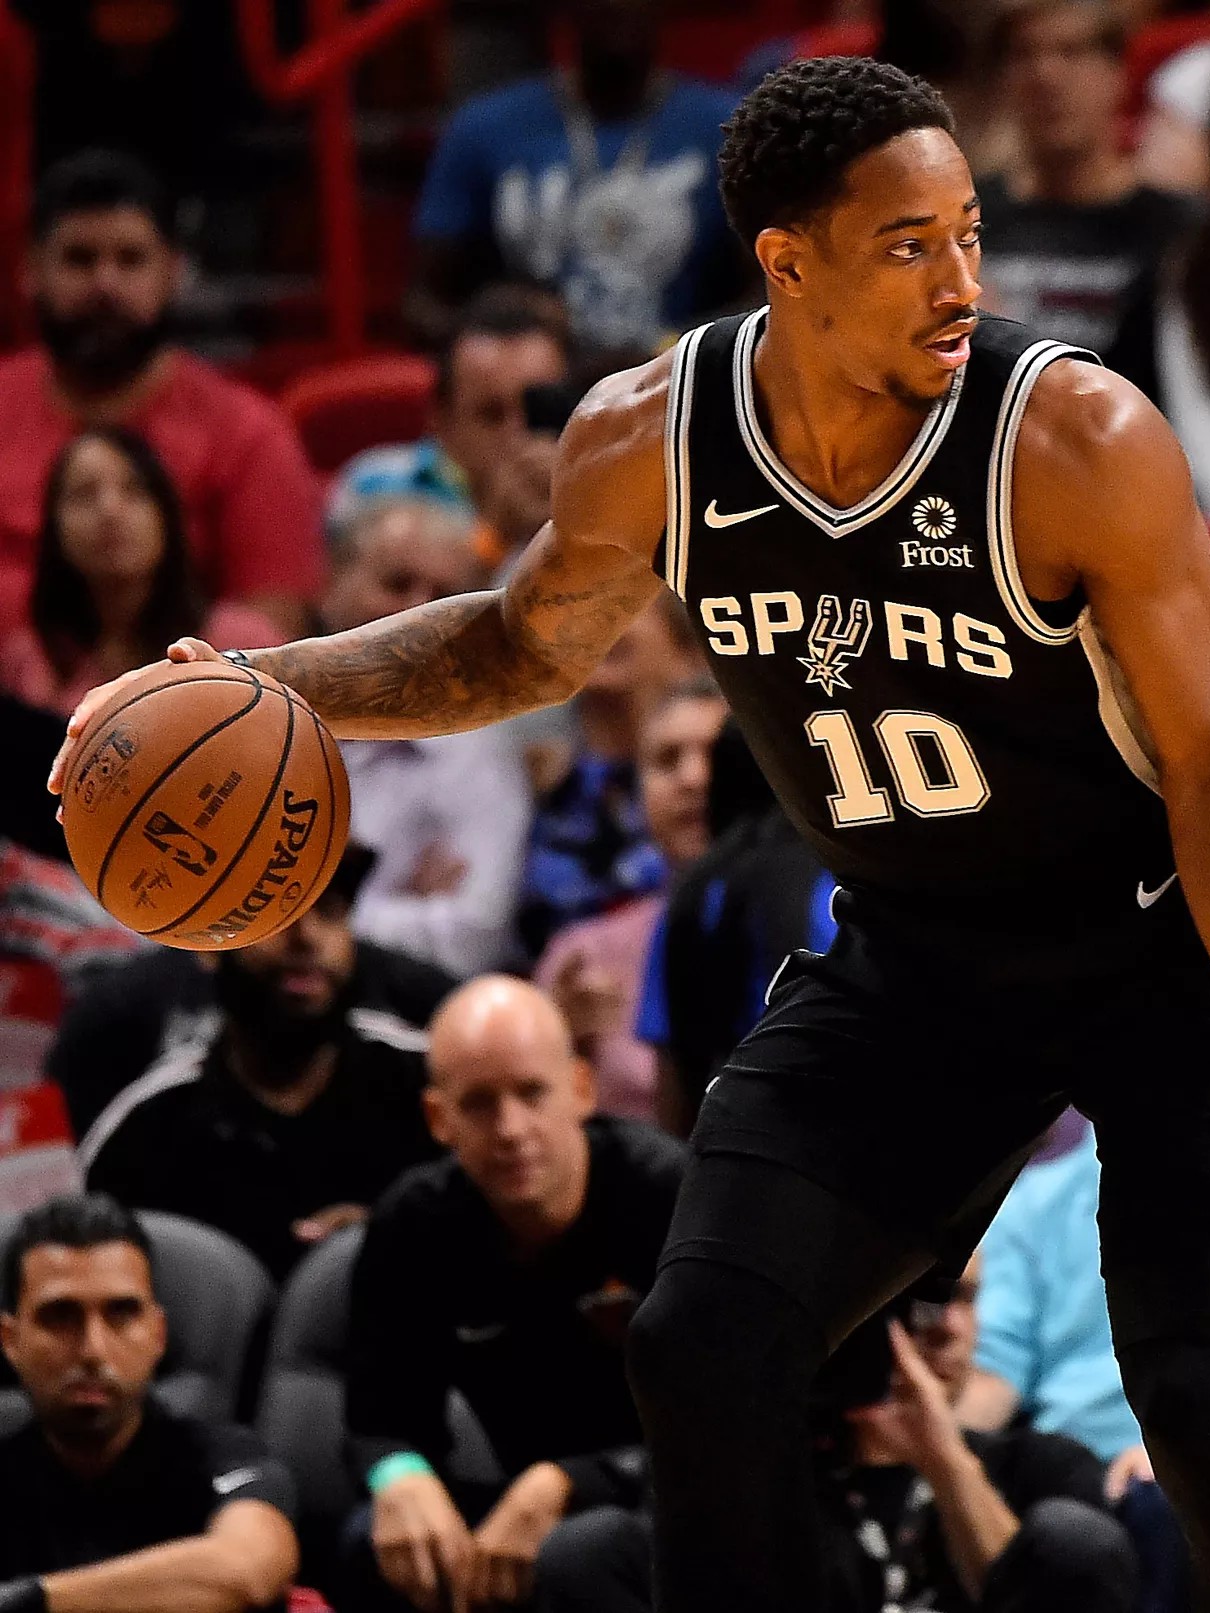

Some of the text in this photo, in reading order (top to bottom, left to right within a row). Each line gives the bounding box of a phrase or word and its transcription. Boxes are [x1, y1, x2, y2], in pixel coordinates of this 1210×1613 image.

[898, 540, 976, 569] Frost
[699, 590, 1014, 697] SPURS
[803, 708, 993, 829] 10
